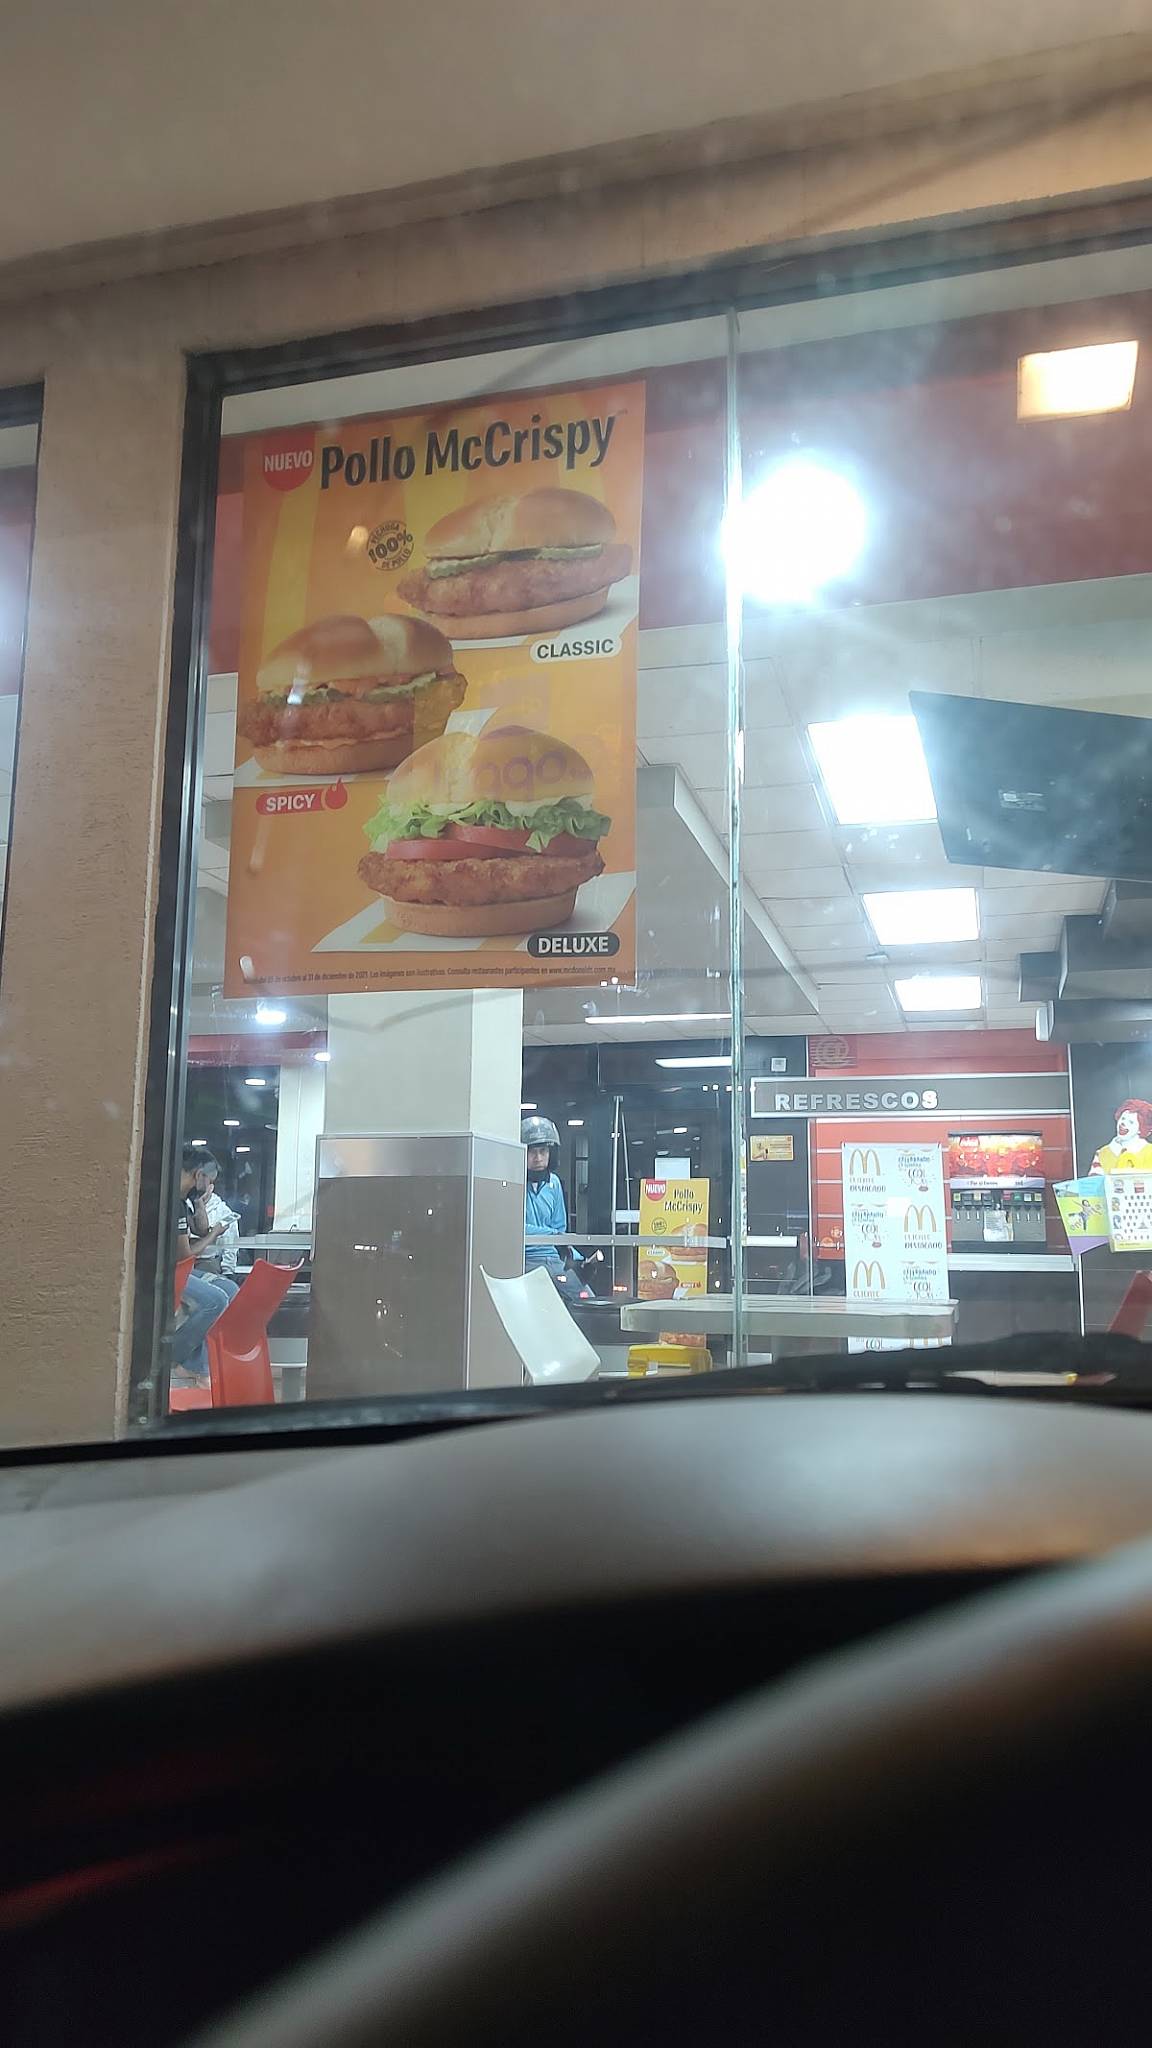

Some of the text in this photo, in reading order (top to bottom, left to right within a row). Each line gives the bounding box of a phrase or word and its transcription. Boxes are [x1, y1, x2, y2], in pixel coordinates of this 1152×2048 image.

[263, 450, 313, 473] NUEVO
[320, 413, 616, 490] Pollo McCrispy
[368, 528, 413, 565] 100%
[536, 638, 614, 659] CLASSIC
[266, 793, 316, 813] SPICY
[538, 935, 609, 954] DELUXE
[775, 1090, 939, 1111] REFRESCOS
[645, 1183, 666, 1195] NUEVO
[674, 1188, 694, 1200] Pollo
[664, 1201, 703, 1215] McCrispy
